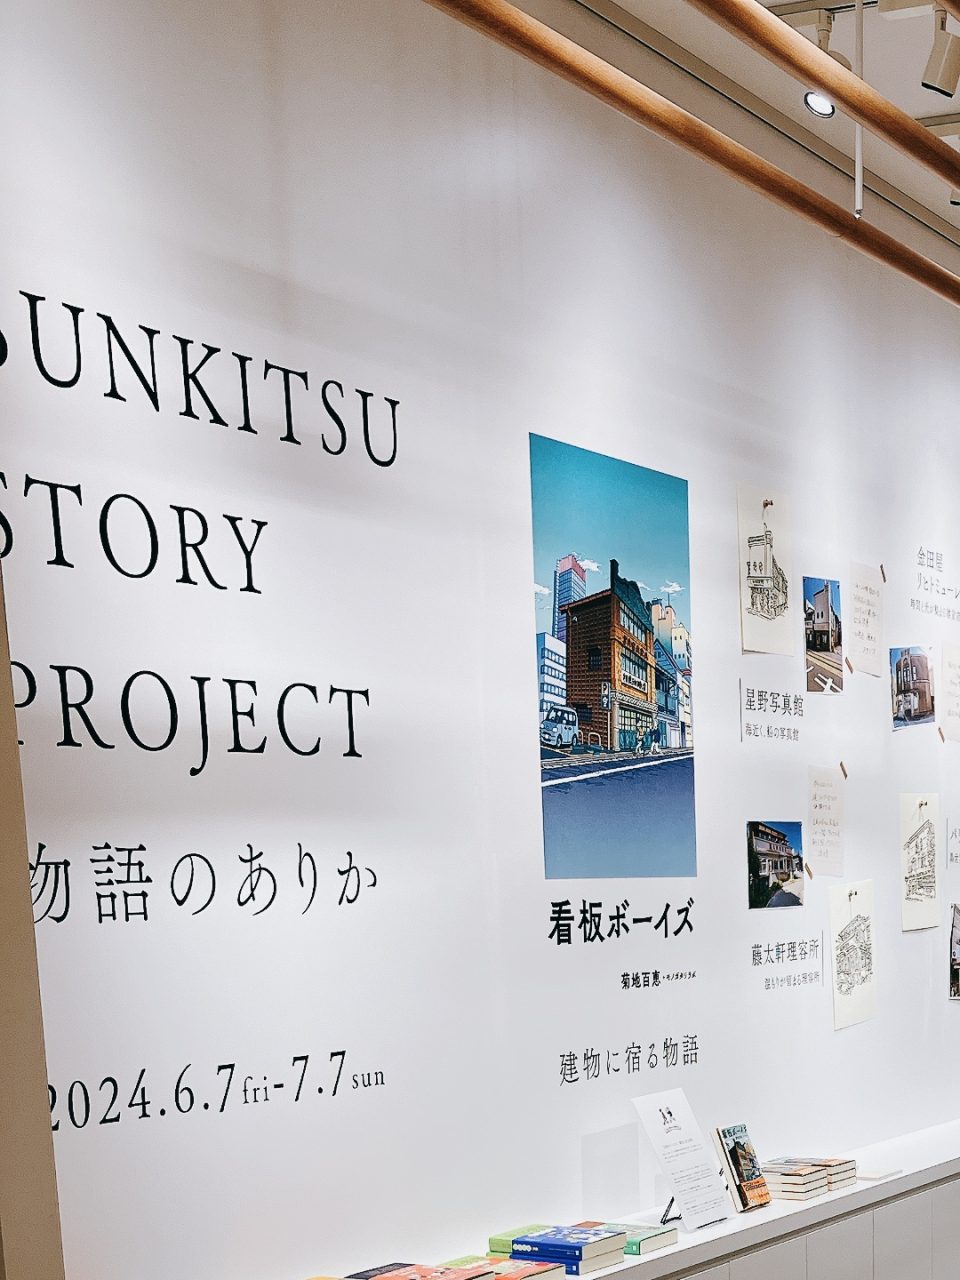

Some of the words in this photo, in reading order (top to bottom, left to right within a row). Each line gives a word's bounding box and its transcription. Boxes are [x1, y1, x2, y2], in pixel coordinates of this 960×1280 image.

[0, 290, 400, 467] UNKITSU
[745, 687, 804, 718] 星野写真館
[29, 842, 378, 925] 物語のありか
[548, 897, 695, 945] 看板ボーイズ
[559, 1034, 699, 1087] 建物に宿る物語
